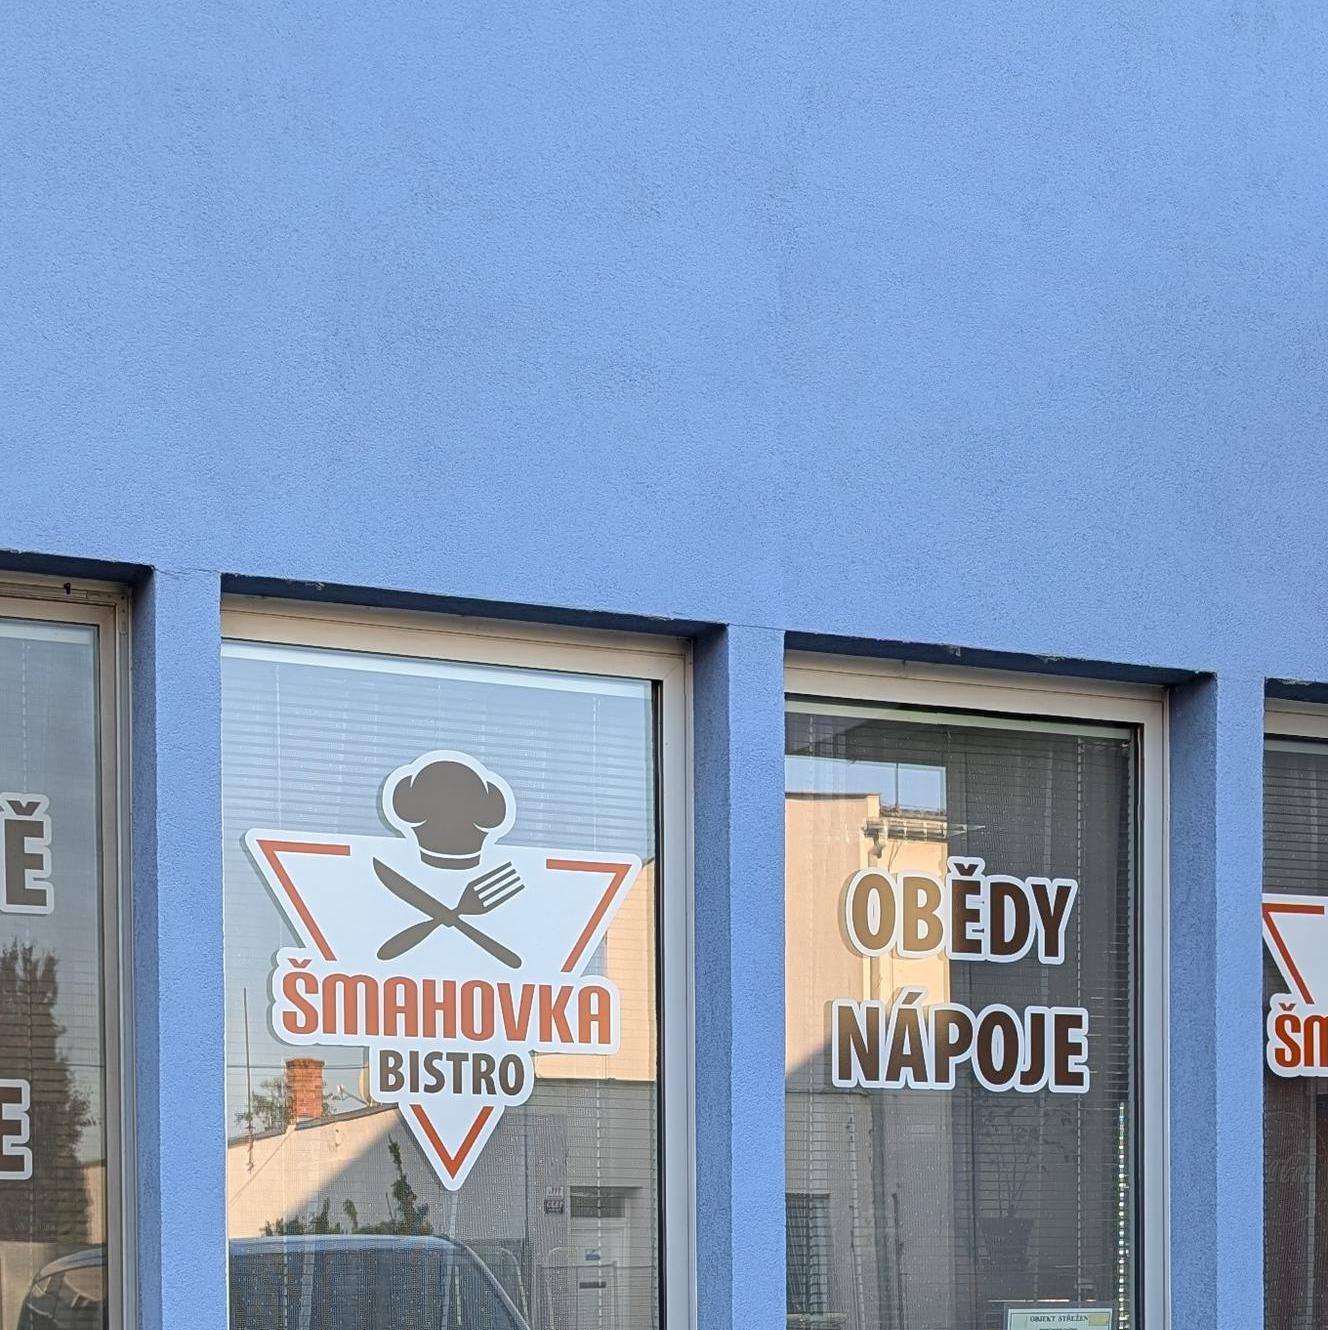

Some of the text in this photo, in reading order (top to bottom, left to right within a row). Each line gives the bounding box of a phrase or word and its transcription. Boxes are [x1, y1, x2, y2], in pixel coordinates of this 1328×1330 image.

[852, 863, 1071, 958] OBĚDY
[282, 958, 612, 1044] ŠMAHOVKA
[838, 991, 1085, 1087] NÁPOJE
[379, 1050, 525, 1096] BISTRO
